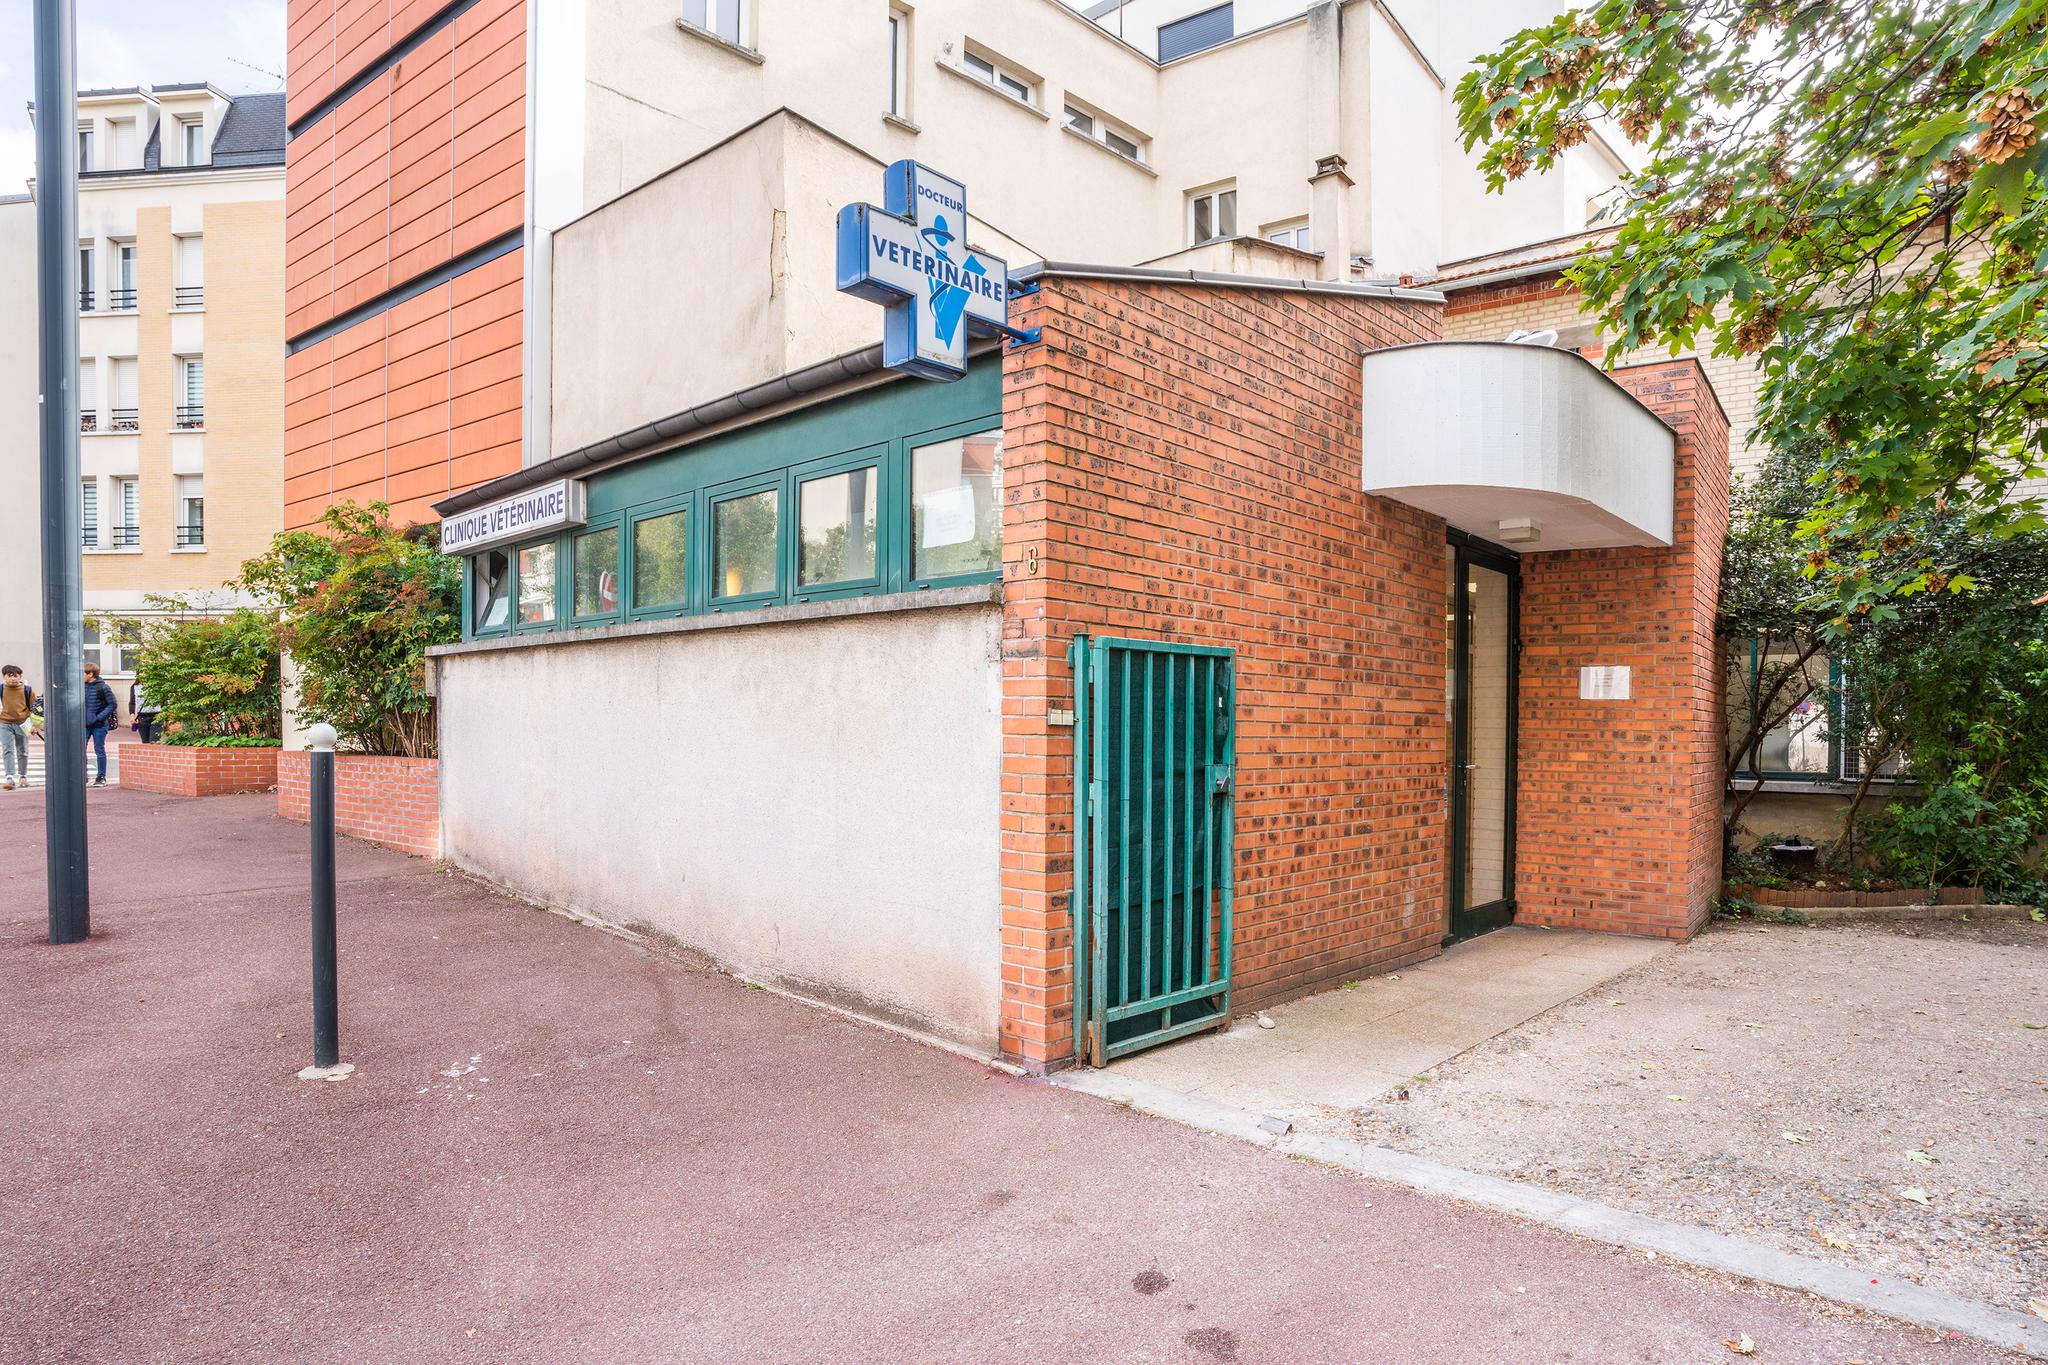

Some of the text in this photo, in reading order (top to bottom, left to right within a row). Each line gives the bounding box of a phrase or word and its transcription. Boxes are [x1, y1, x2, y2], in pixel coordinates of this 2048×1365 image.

[918, 184, 963, 213] DOCTEUR
[872, 234, 1002, 302] VETERINAIRE
[444, 490, 563, 546] CLINIQUE VÉTÉRINAIRE
